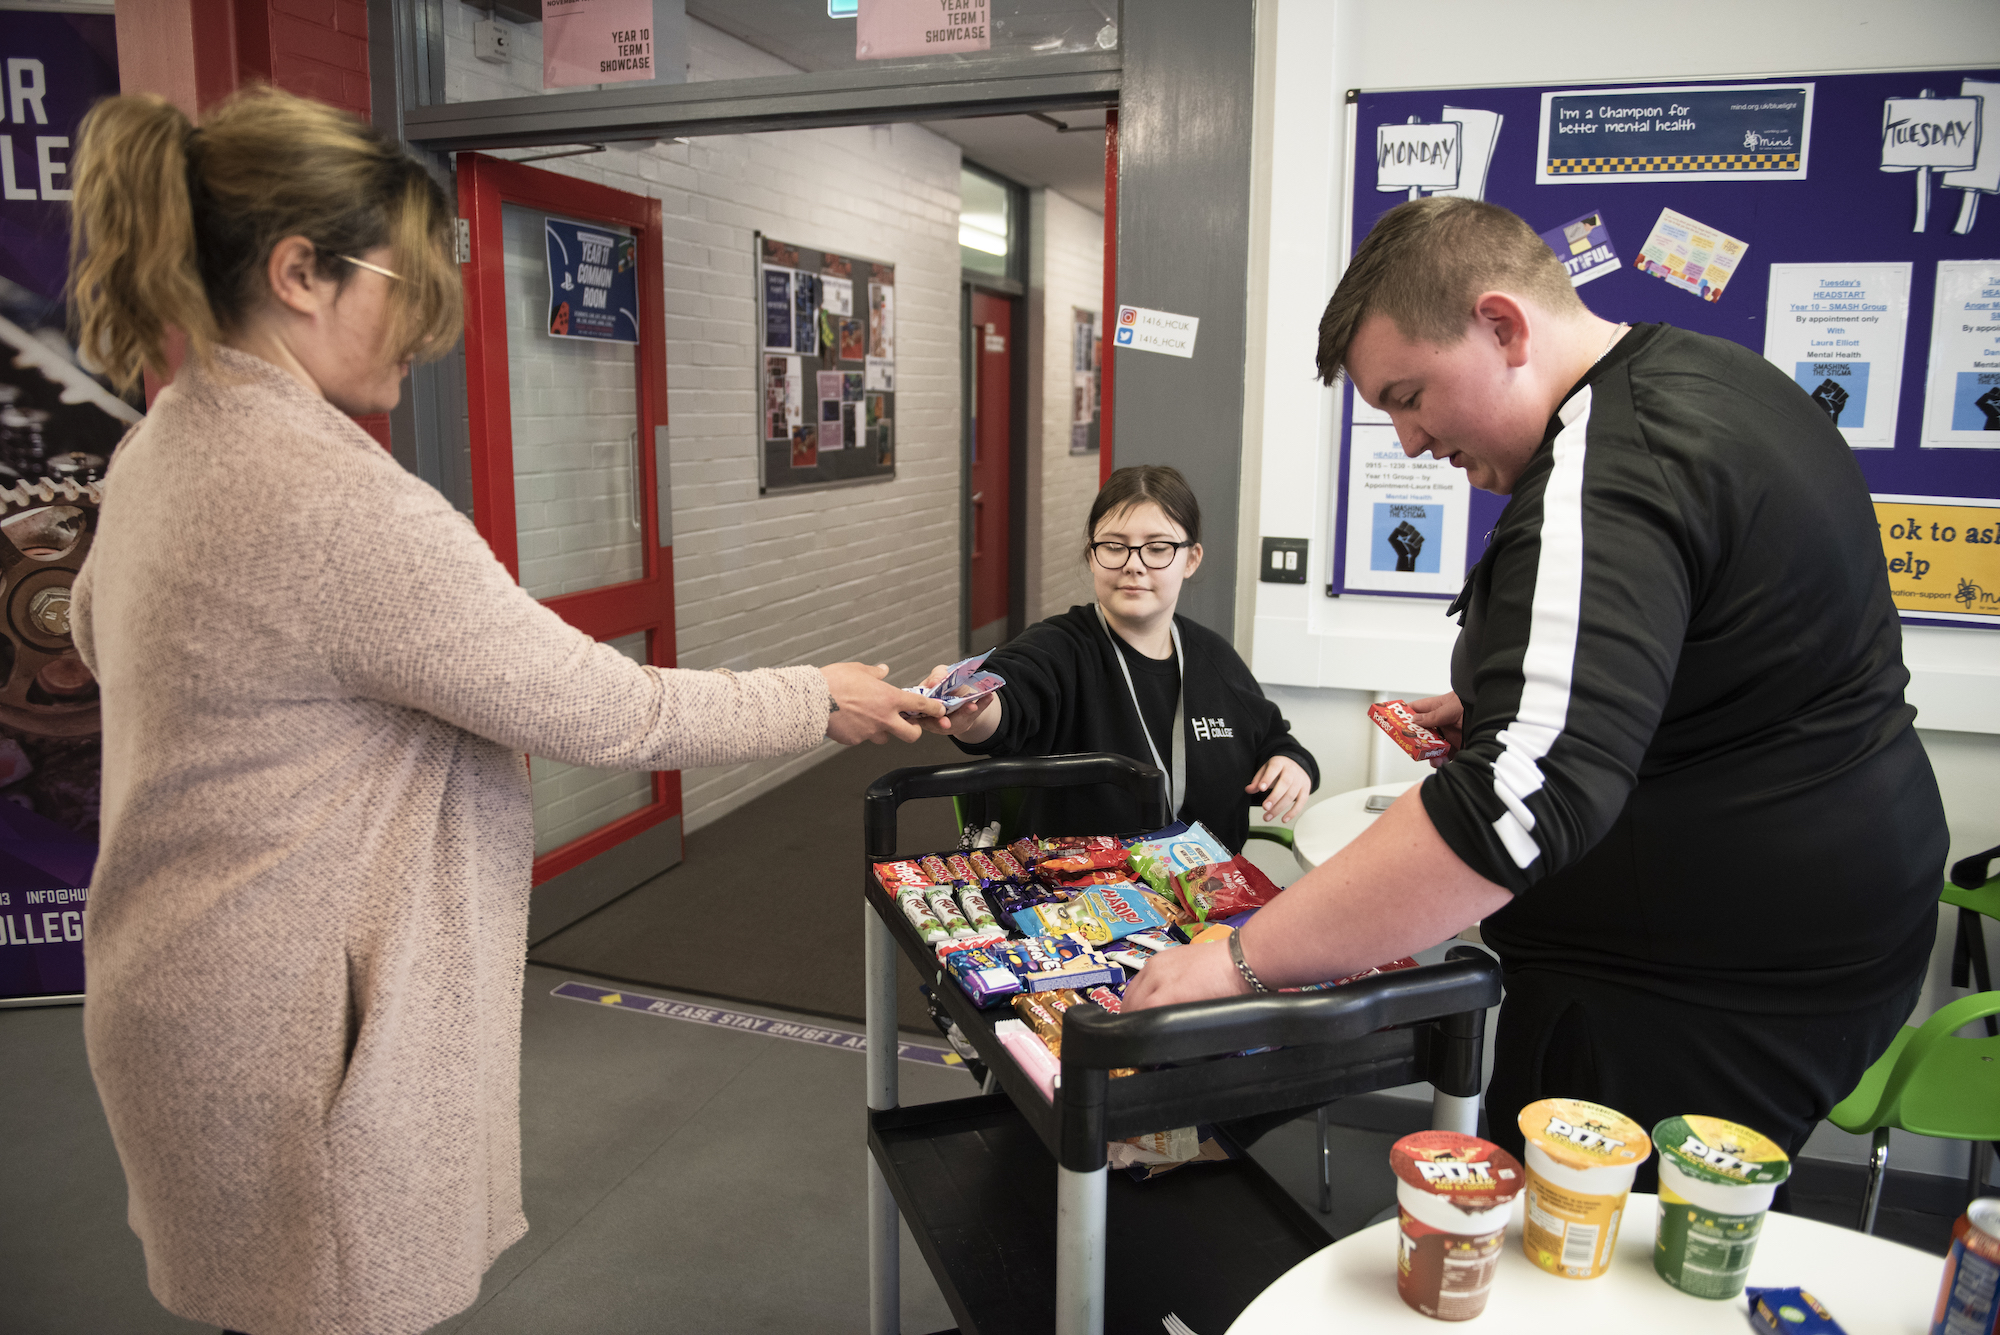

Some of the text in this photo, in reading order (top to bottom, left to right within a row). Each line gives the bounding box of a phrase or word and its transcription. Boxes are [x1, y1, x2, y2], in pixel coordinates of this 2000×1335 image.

[941, 0, 970, 11] YEAR
[947, 11, 985, 26] TERM 1
[611, 28, 650, 43] YEAR 10
[925, 26, 986, 43] SHOWCASE
[618, 43, 650, 57] TERM 1
[600, 57, 650, 73] SHOWCASE
[0, 58, 49, 124] R
[1560, 104, 1691, 121] I'm a Champion for
[1730, 102, 1797, 111] mind.org.uk/bluelight
[1559, 119, 1696, 134] better mental health
[1885, 117, 1973, 148] TUESDAY
[1759, 136, 1794, 147] mind
[1381, 138, 1455, 170] MONDAY
[1723, 245, 1737, 255] TIPS
[1726, 241, 1739, 250] TOP
[582, 242, 611, 265] YEAR 11
[577, 263, 614, 289] COMMON
[1819, 279, 1861, 288] Tuesday's
[582, 286, 607, 309] ROOM
[1813, 291, 1865, 299] HEADSTART
[1790, 303, 1808, 311] Year
[1811, 303, 1820, 311] 10
[1829, 303, 1859, 311] SMASH
[1861, 303, 1887, 311] Group
[1142, 316, 1191, 331] 1416_HCUK
[1796, 315, 1879, 324] By appointment only
[1962, 324, 1974, 333] By
[1139, 334, 1187, 349] 1416_HCUK
[1813, 363, 1850, 371] SMASHING
[1373, 451, 1407, 459] HEADSTA
[1392, 473, 1414, 481] Group
[1421, 474, 1430, 482] by
[1889, 518, 1922, 540] ok
[1930, 522, 1957, 543] to
[1889, 551, 1931, 580] elp
[1393, 730, 1413, 752] TOFFEE
[1099, 888, 1146, 925] HARIBO
[1090, 986, 1122, 1014] WISP
[646, 1000, 910, 1055] PLEASE STAY 2M/6FT APT
[1545, 1116, 1626, 1152] POT
[1680, 1135, 1763, 1177] POT
[1413, 1160, 1491, 1180] POT
